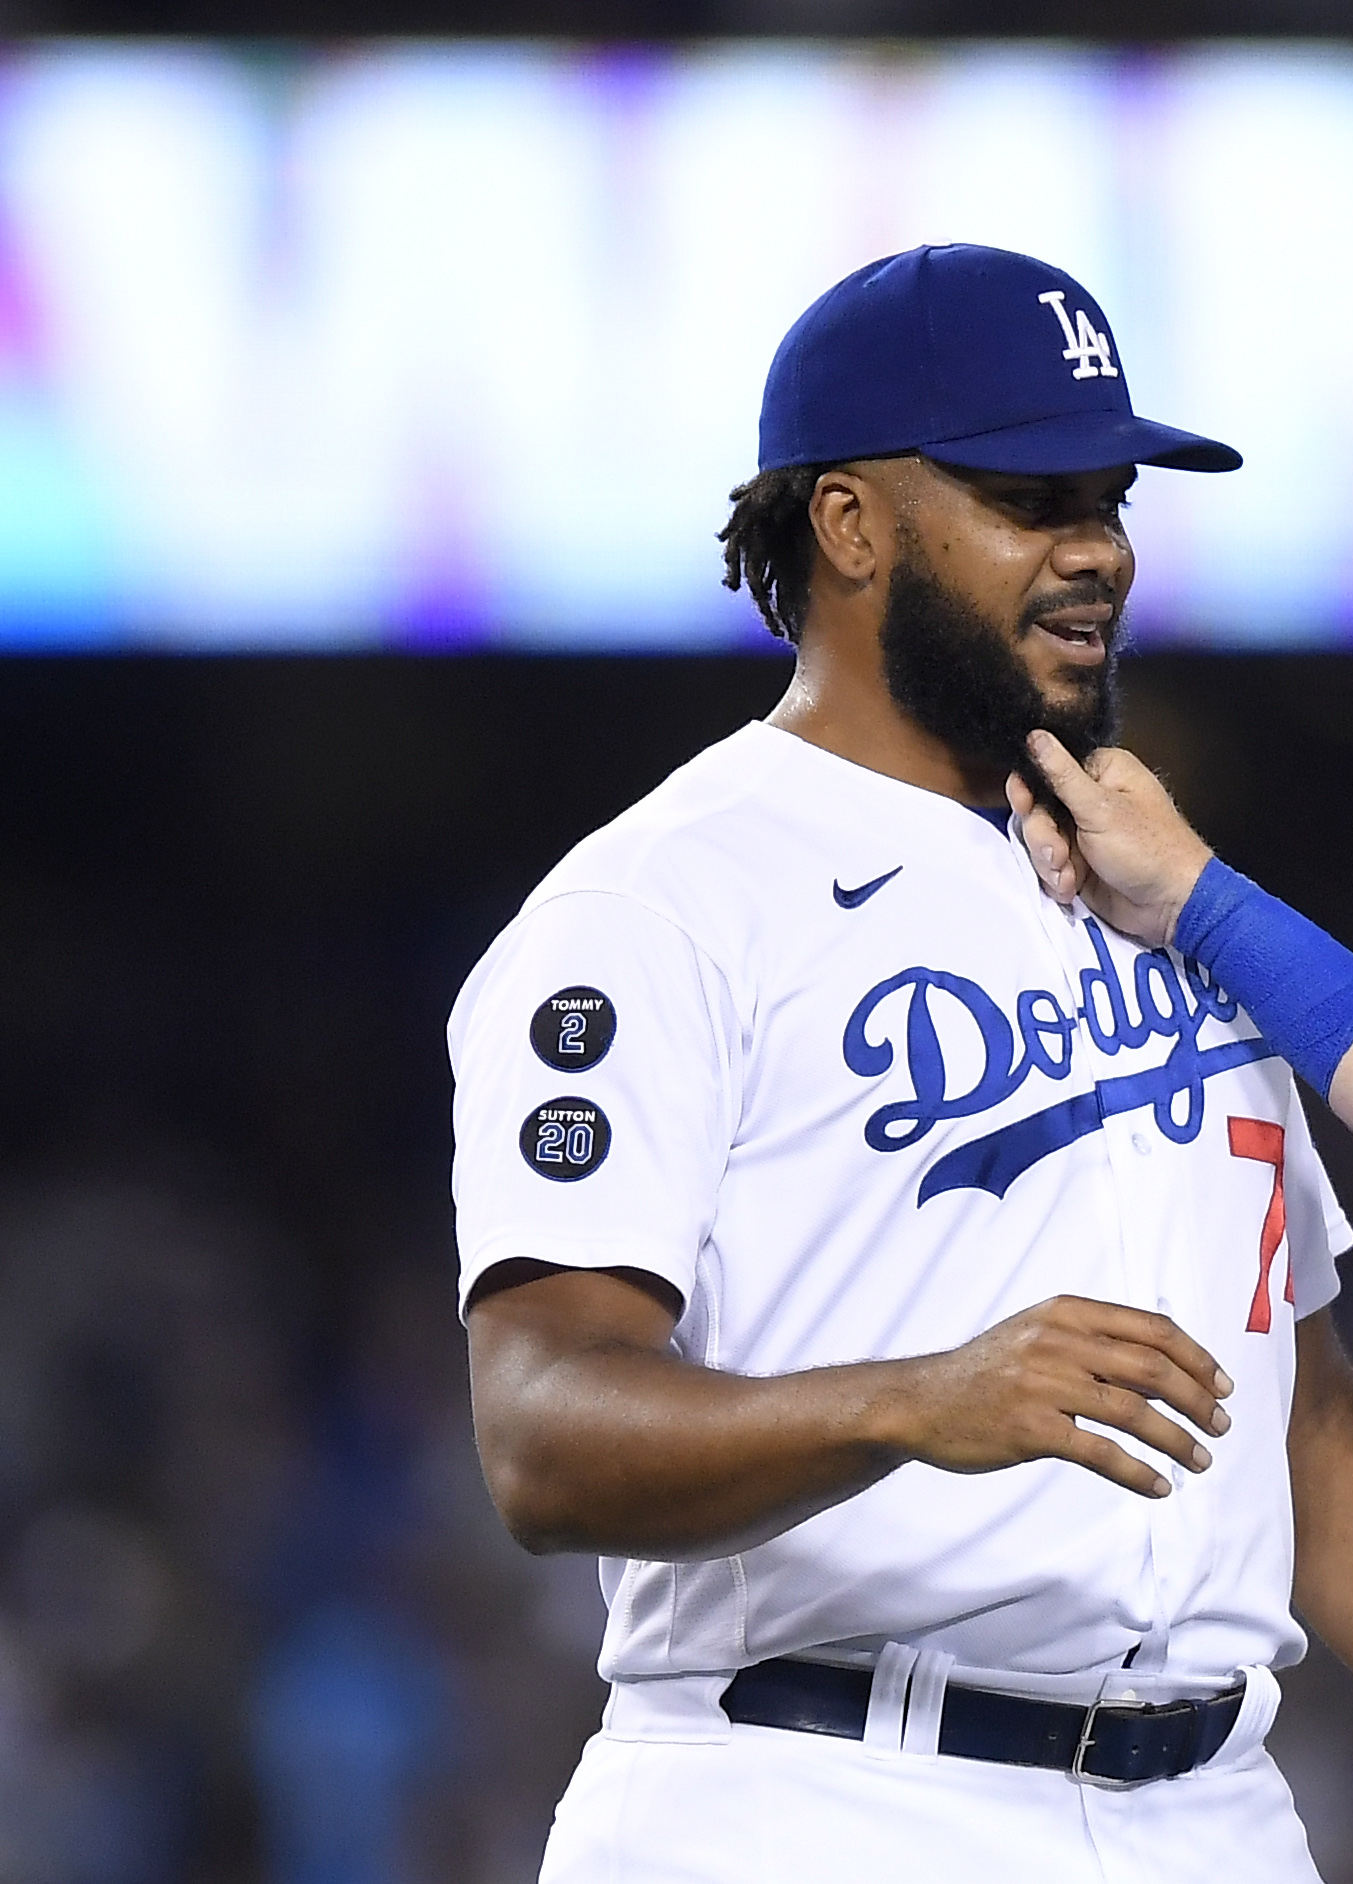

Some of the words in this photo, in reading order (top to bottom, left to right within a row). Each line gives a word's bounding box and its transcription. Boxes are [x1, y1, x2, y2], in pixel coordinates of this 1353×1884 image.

[1038, 290, 1118, 380] LA
[551, 999, 604, 1011] TOMMY
[558, 1012, 587, 1054] 2
[537, 1109, 596, 1122] SUTTON
[535, 1121, 594, 1165] 20
[1227, 1115, 1295, 1334] 7
